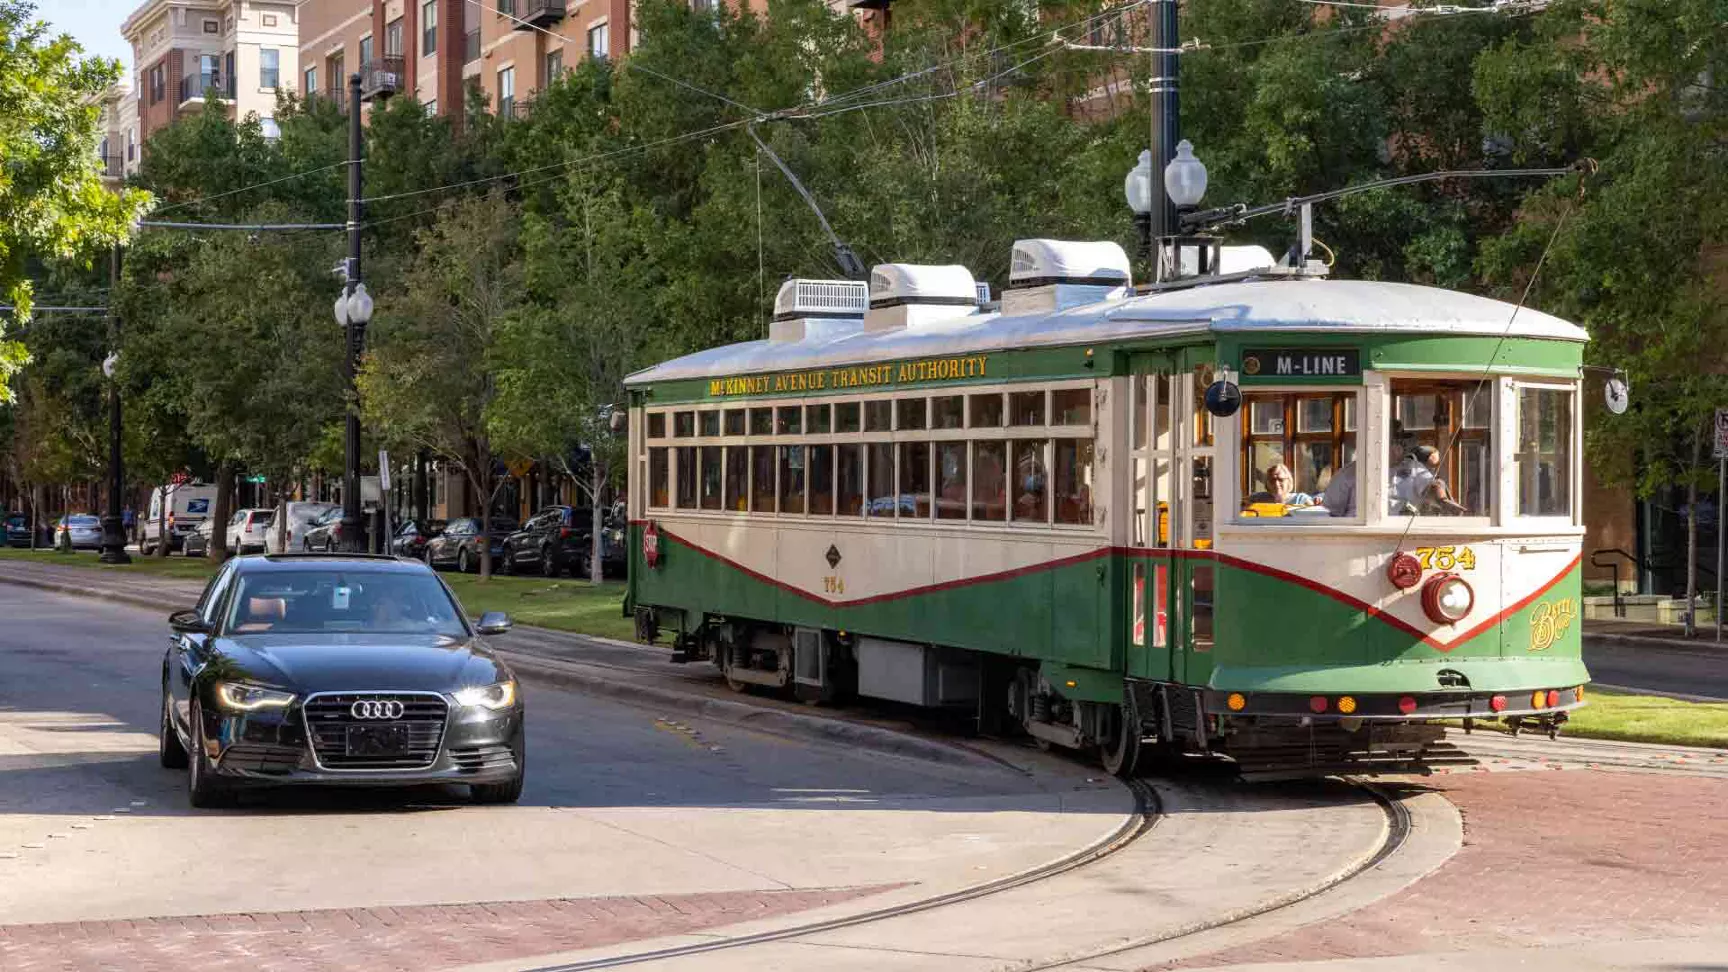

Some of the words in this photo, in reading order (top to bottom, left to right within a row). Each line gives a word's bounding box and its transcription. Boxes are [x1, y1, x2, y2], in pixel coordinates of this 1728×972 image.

[775, 372, 825, 391] AVENUE
[832, 365, 892, 388] TRANSIT
[898, 355, 988, 381] AUTHORITY
[1276, 356, 1346, 375] M-LINE
[645, 534, 657, 552] STOP
[1415, 546, 1476, 570] 754
[822, 576, 846, 594] 754
